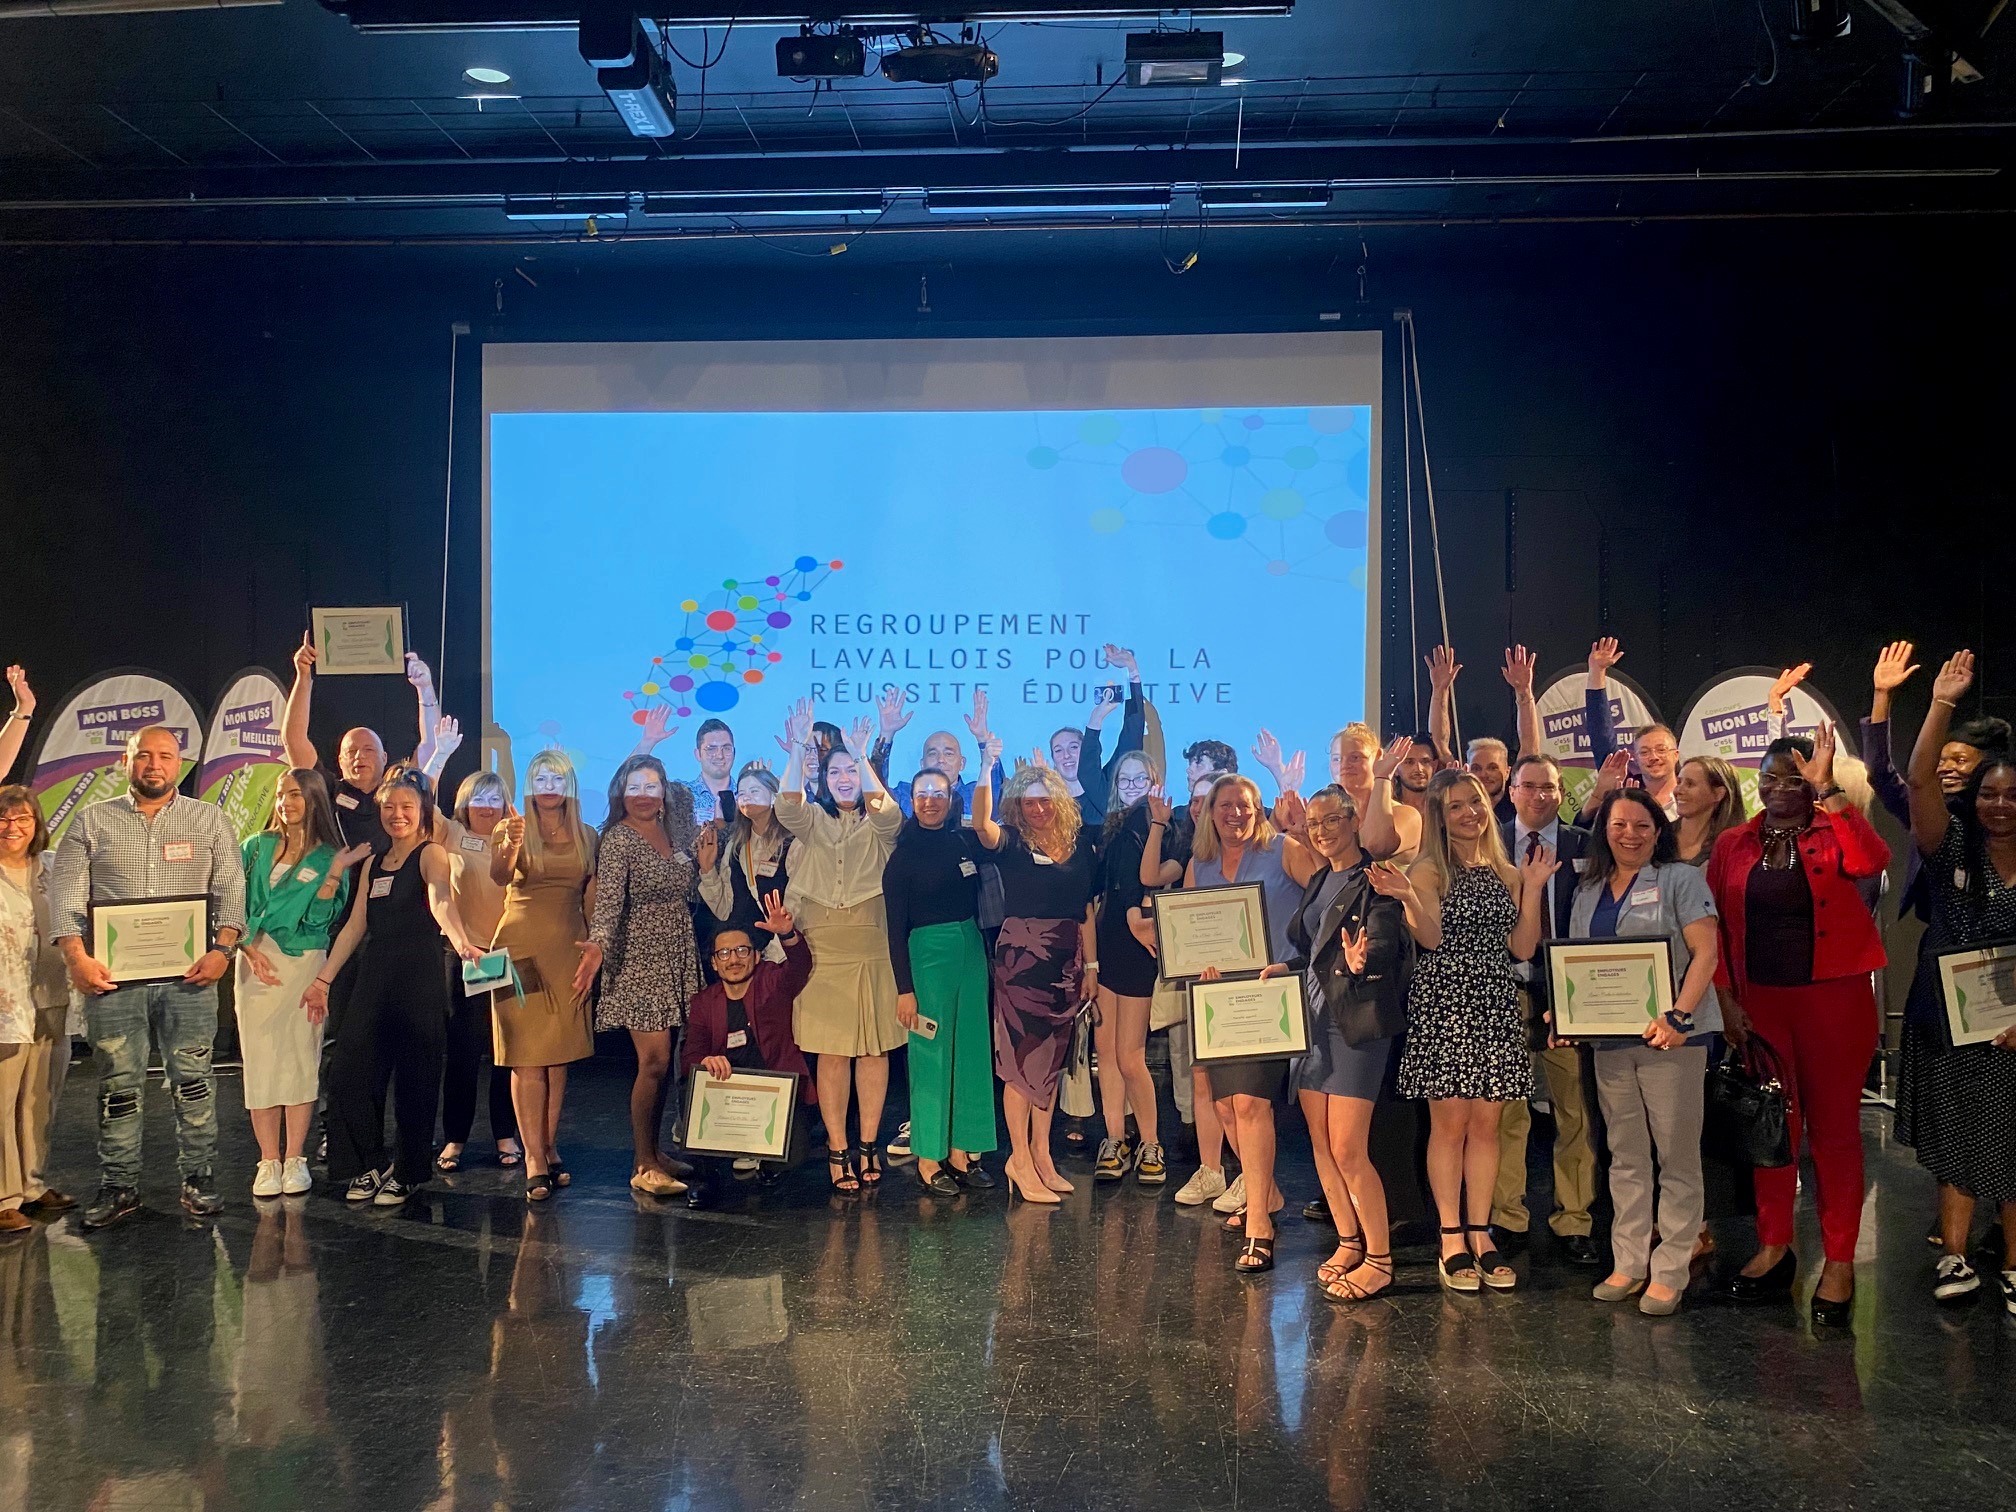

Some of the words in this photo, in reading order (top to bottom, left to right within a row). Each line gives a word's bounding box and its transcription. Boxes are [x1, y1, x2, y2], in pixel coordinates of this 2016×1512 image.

[811, 613, 1092, 635] REGROUPEMENT
[811, 648, 1013, 669] LAVALLOIS
[1046, 648, 1135, 669] POU
[1169, 648, 1212, 669] LA
[1023, 678, 1232, 704] ÉDUTIVE
[82, 710, 118, 725] MON
[120, 704, 160, 720] BOSS
[224, 712, 247, 726] MON
[248, 706, 270, 721] BOSS
[1548, 714, 1583, 732] MON
[1707, 715, 1747, 735] MON
[1748, 705, 1788, 725] BOS
[224, 762, 254, 819] YEURS
[47, 800, 74, 833] AGNANT
[74, 771, 95, 796] 2023
[1564, 791, 1581, 813] POU
